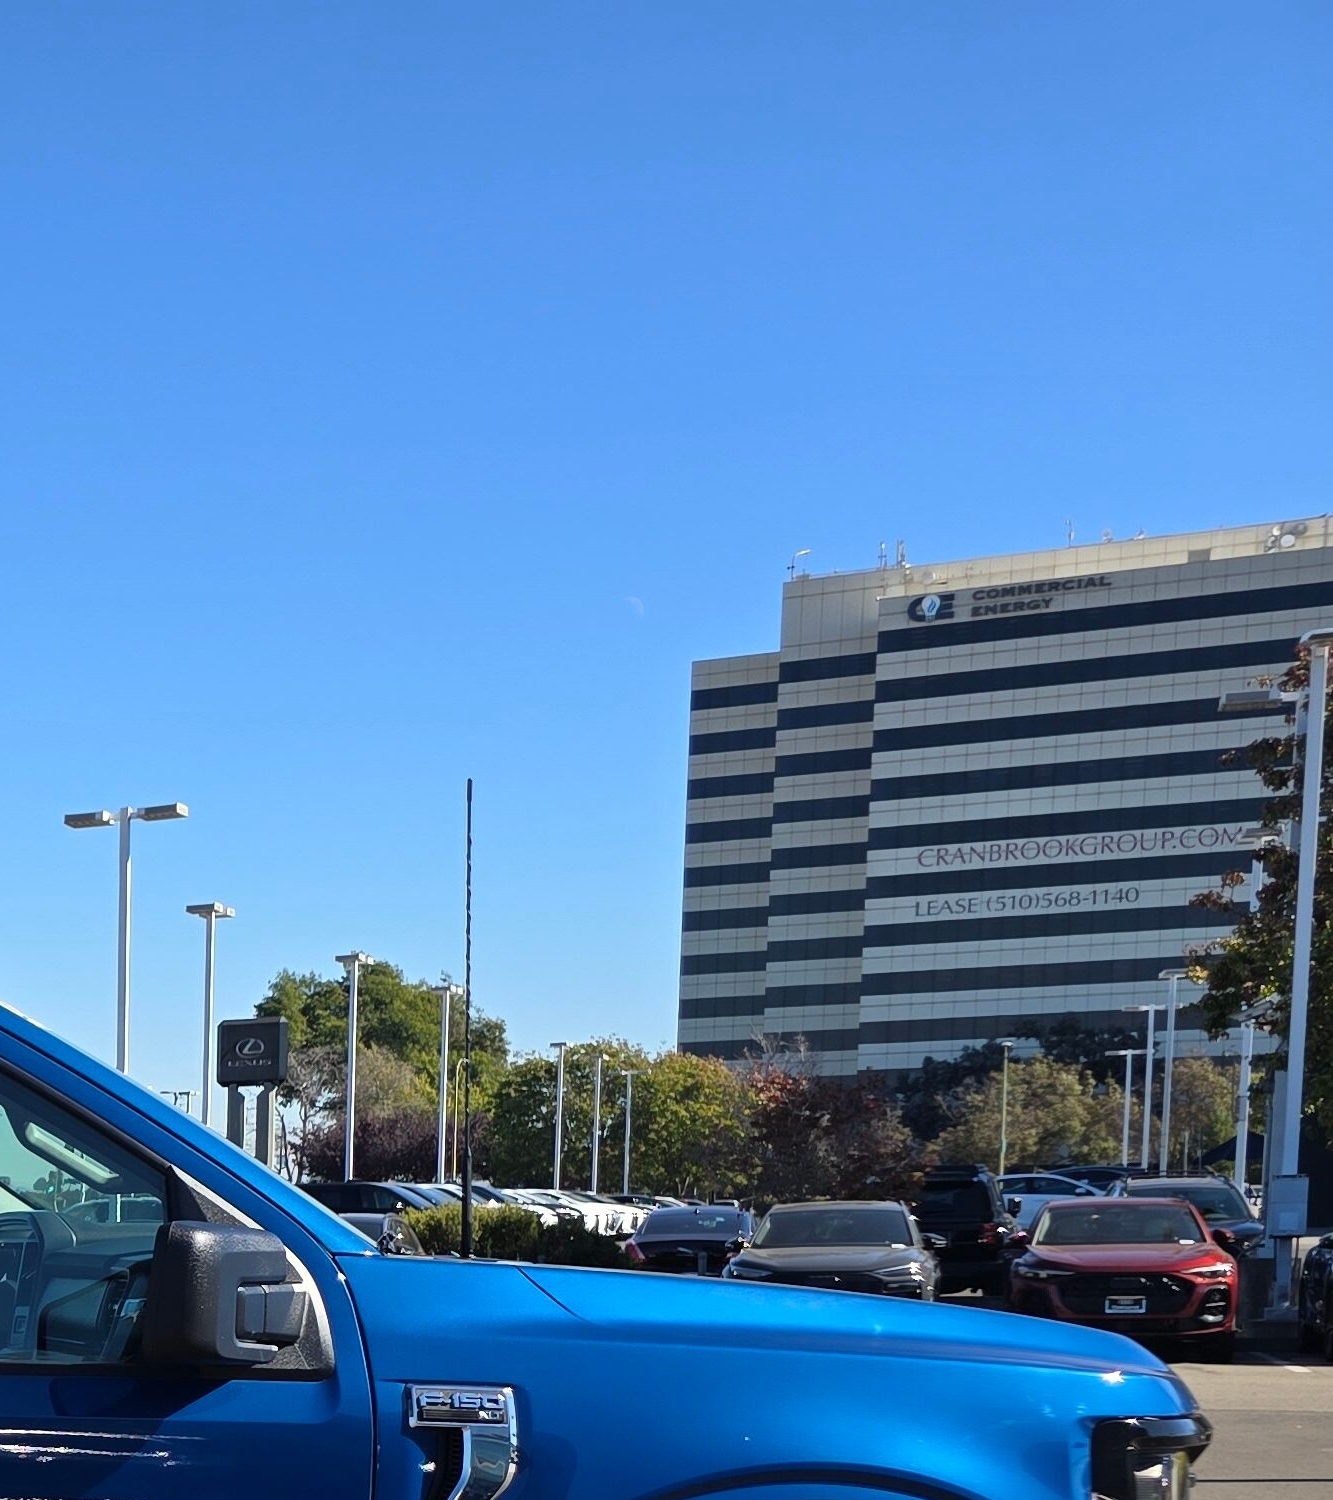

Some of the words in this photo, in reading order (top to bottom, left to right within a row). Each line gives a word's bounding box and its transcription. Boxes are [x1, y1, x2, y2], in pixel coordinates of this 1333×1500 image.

[971, 575, 1113, 601] COMMERCIAL
[970, 597, 1054, 618] ENERGY
[916, 825, 1244, 869] CRANBROOKGROUP.COM
[914, 896, 979, 918] LEASE
[418, 1391, 505, 1409] F-150
